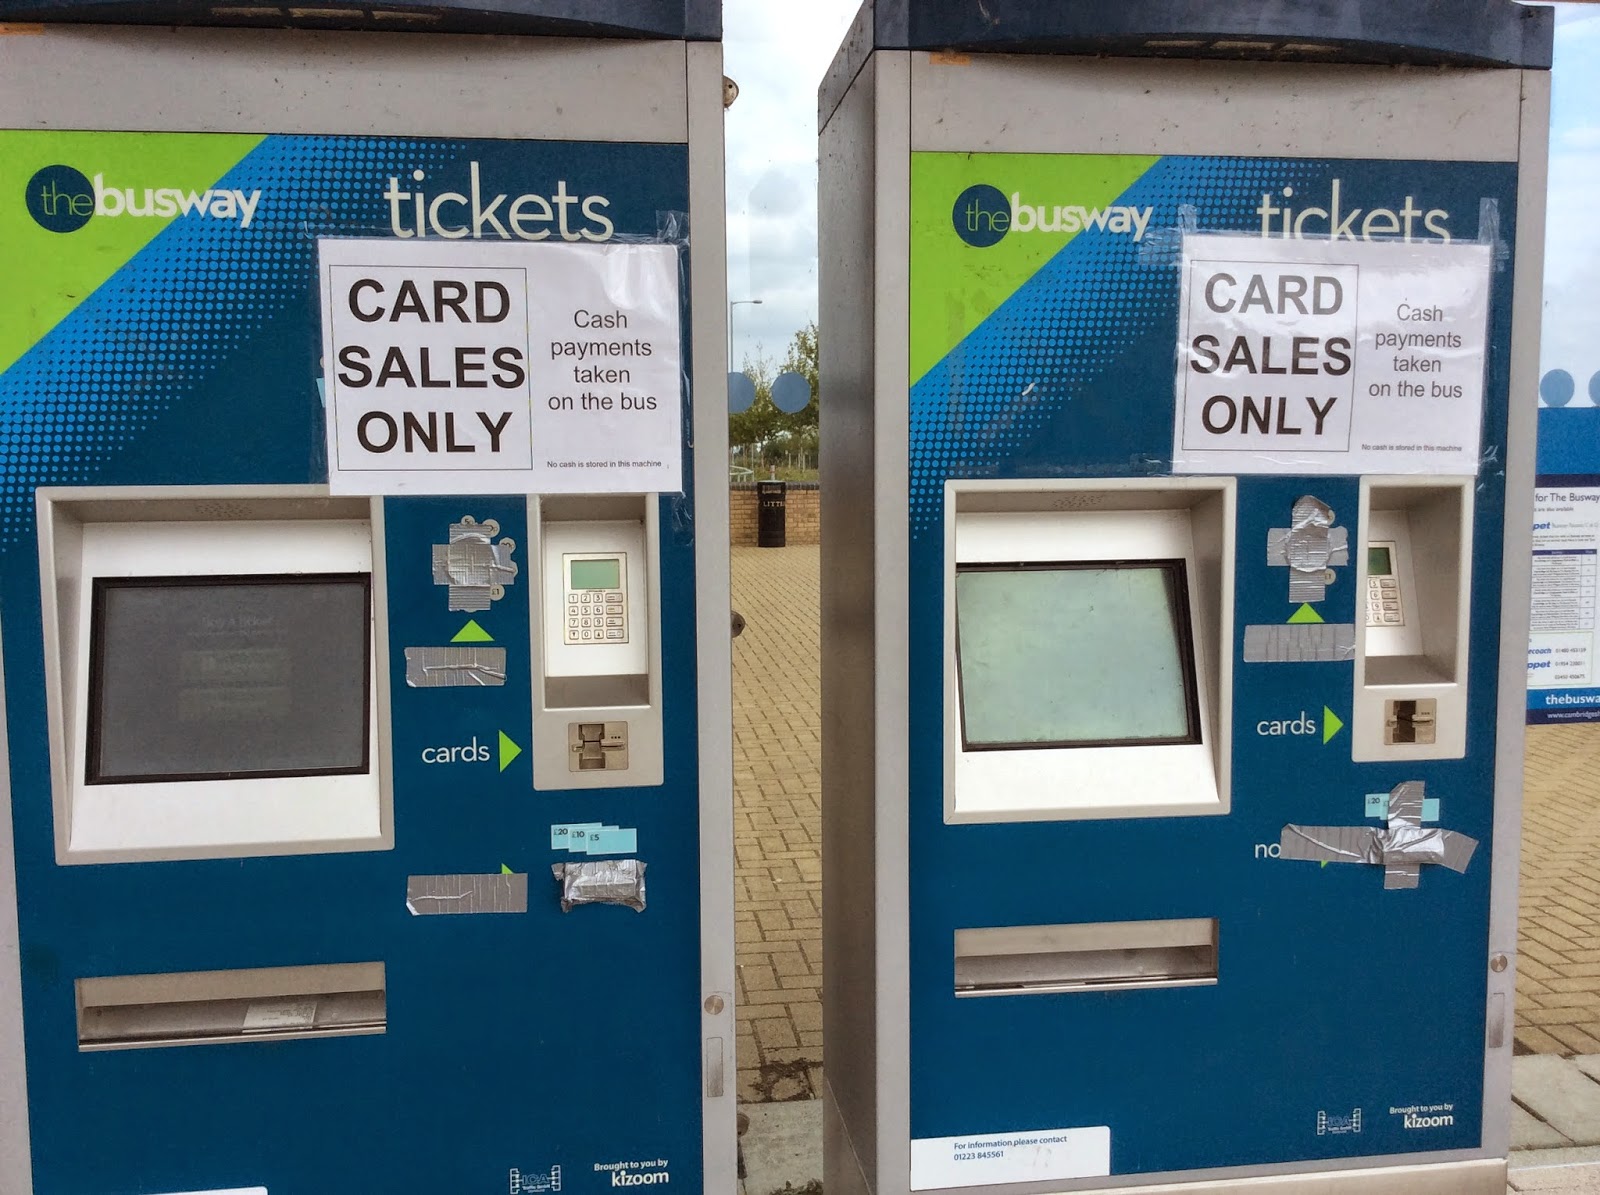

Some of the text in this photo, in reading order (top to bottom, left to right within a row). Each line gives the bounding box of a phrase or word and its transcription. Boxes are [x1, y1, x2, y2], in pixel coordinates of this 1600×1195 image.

[384, 161, 613, 241] tickets
[1256, 178, 1451, 243] tickets
[347, 278, 510, 324] CARD
[1204, 272, 1344, 316] CARD
[573, 309, 628, 329] Cash
[1397, 303, 1443, 322] Cash
[550, 338, 652, 359] payments
[1374, 330, 1462, 350] payments
[1190, 334, 1352, 377] SALES
[1392, 355, 1442, 373] taken
[338, 344, 525, 389] SALES
[573, 363, 631, 383] taken
[1368, 380, 1463, 398] on the bus
[548, 391, 657, 411] on the bus
[1201, 394, 1337, 436] ONLY
[356, 410, 512, 453] ONLY
[1535, 492, 1600, 503] for The Busway
[1256, 711, 1316, 735] cards
[421, 736, 490, 764] cards
[553, 828, 568, 836] £20
[572, 830, 585, 838] £10
[589, 833, 600, 841] £5
[1389, 1106, 1420, 1115] Brought
[1429, 1105, 1443, 1114] you
[1443, 1103, 1453, 1112] by
[1404, 1113, 1454, 1129] kizoom
[953, 1135, 1068, 1150] For information please contact
[594, 1159, 668, 1172] Brought to you by
[953, 1150, 1004, 1161] 01223 845561
[612, 1170, 669, 1187] kizoom
